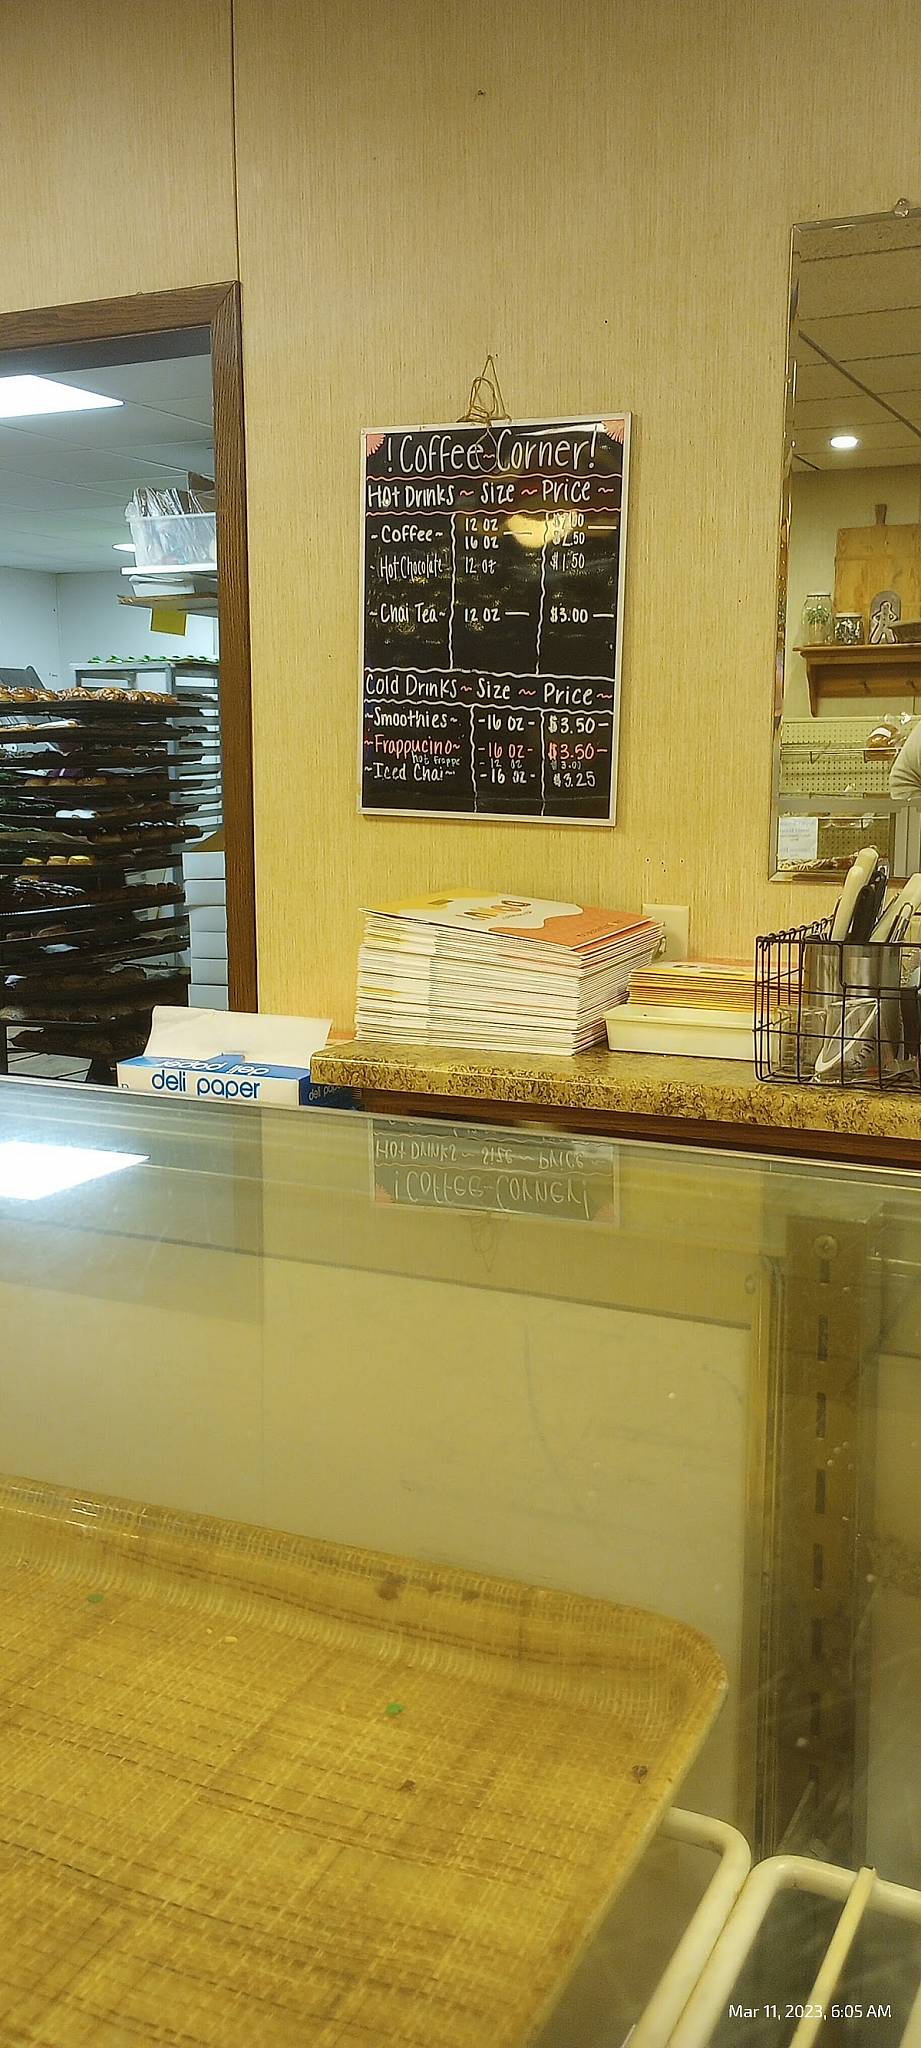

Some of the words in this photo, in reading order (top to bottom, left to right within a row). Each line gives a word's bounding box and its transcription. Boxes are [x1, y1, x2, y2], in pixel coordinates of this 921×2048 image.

[367, 484, 400, 508] Hot
[405, 484, 455, 507] Drinks
[481, 482, 514, 504] Size
[542, 478, 591, 503] Price
[465, 518, 478, 532] 12
[465, 536, 478, 550] 16
[380, 554, 399, 584] Hot
[400, 553, 443, 583] Chocolate
[465, 556, 477, 574] 12
[550, 551, 585, 572] $1.50
[380, 603, 409, 624] Chai
[415, 603, 438, 623] Tea
[464, 607, 482, 623] 12
[549, 607, 588, 624] $3.00
[366, 675, 399, 696] Cold
[476, 678, 511, 700] Size
[544, 682, 593, 706] Price
[547, 715, 595, 734] $3.50
[412, 751, 430, 765] hot
[548, 742, 595, 761] $3.50
[553, 770, 596, 788] $3.25
[156, 1060, 227, 1072] paper
[228, 1064, 270, 1076] deli
[151, 1069, 186, 1092] deli
[196, 1077, 261, 1099] paper
